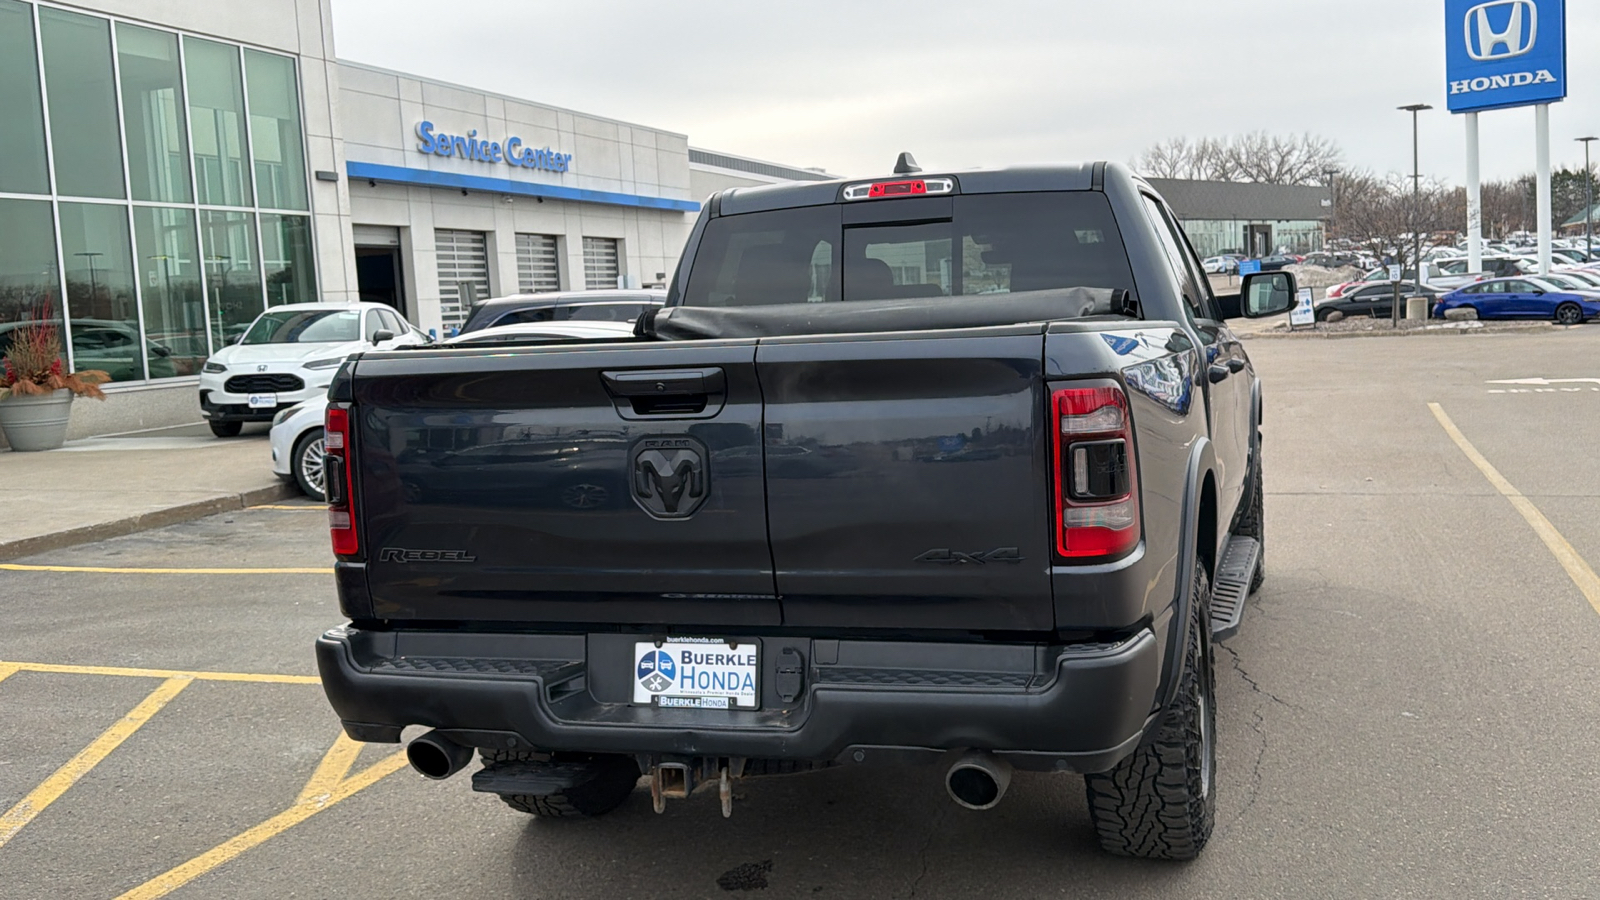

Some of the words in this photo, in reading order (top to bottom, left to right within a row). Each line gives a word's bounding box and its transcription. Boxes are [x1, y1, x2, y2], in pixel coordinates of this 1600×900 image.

[1450, 69, 1556, 94] HONDA
[415, 121, 502, 162] Service
[503, 136, 572, 172] Center
[380, 547, 477, 563] REBEL
[666, 636, 724, 644] buerklehonda.com
[681, 650, 756, 667] BUERKLE
[680, 666, 755, 691] HONDA
[660, 696, 701, 706] BUERKLE
[702, 698, 727, 707] HONDA
